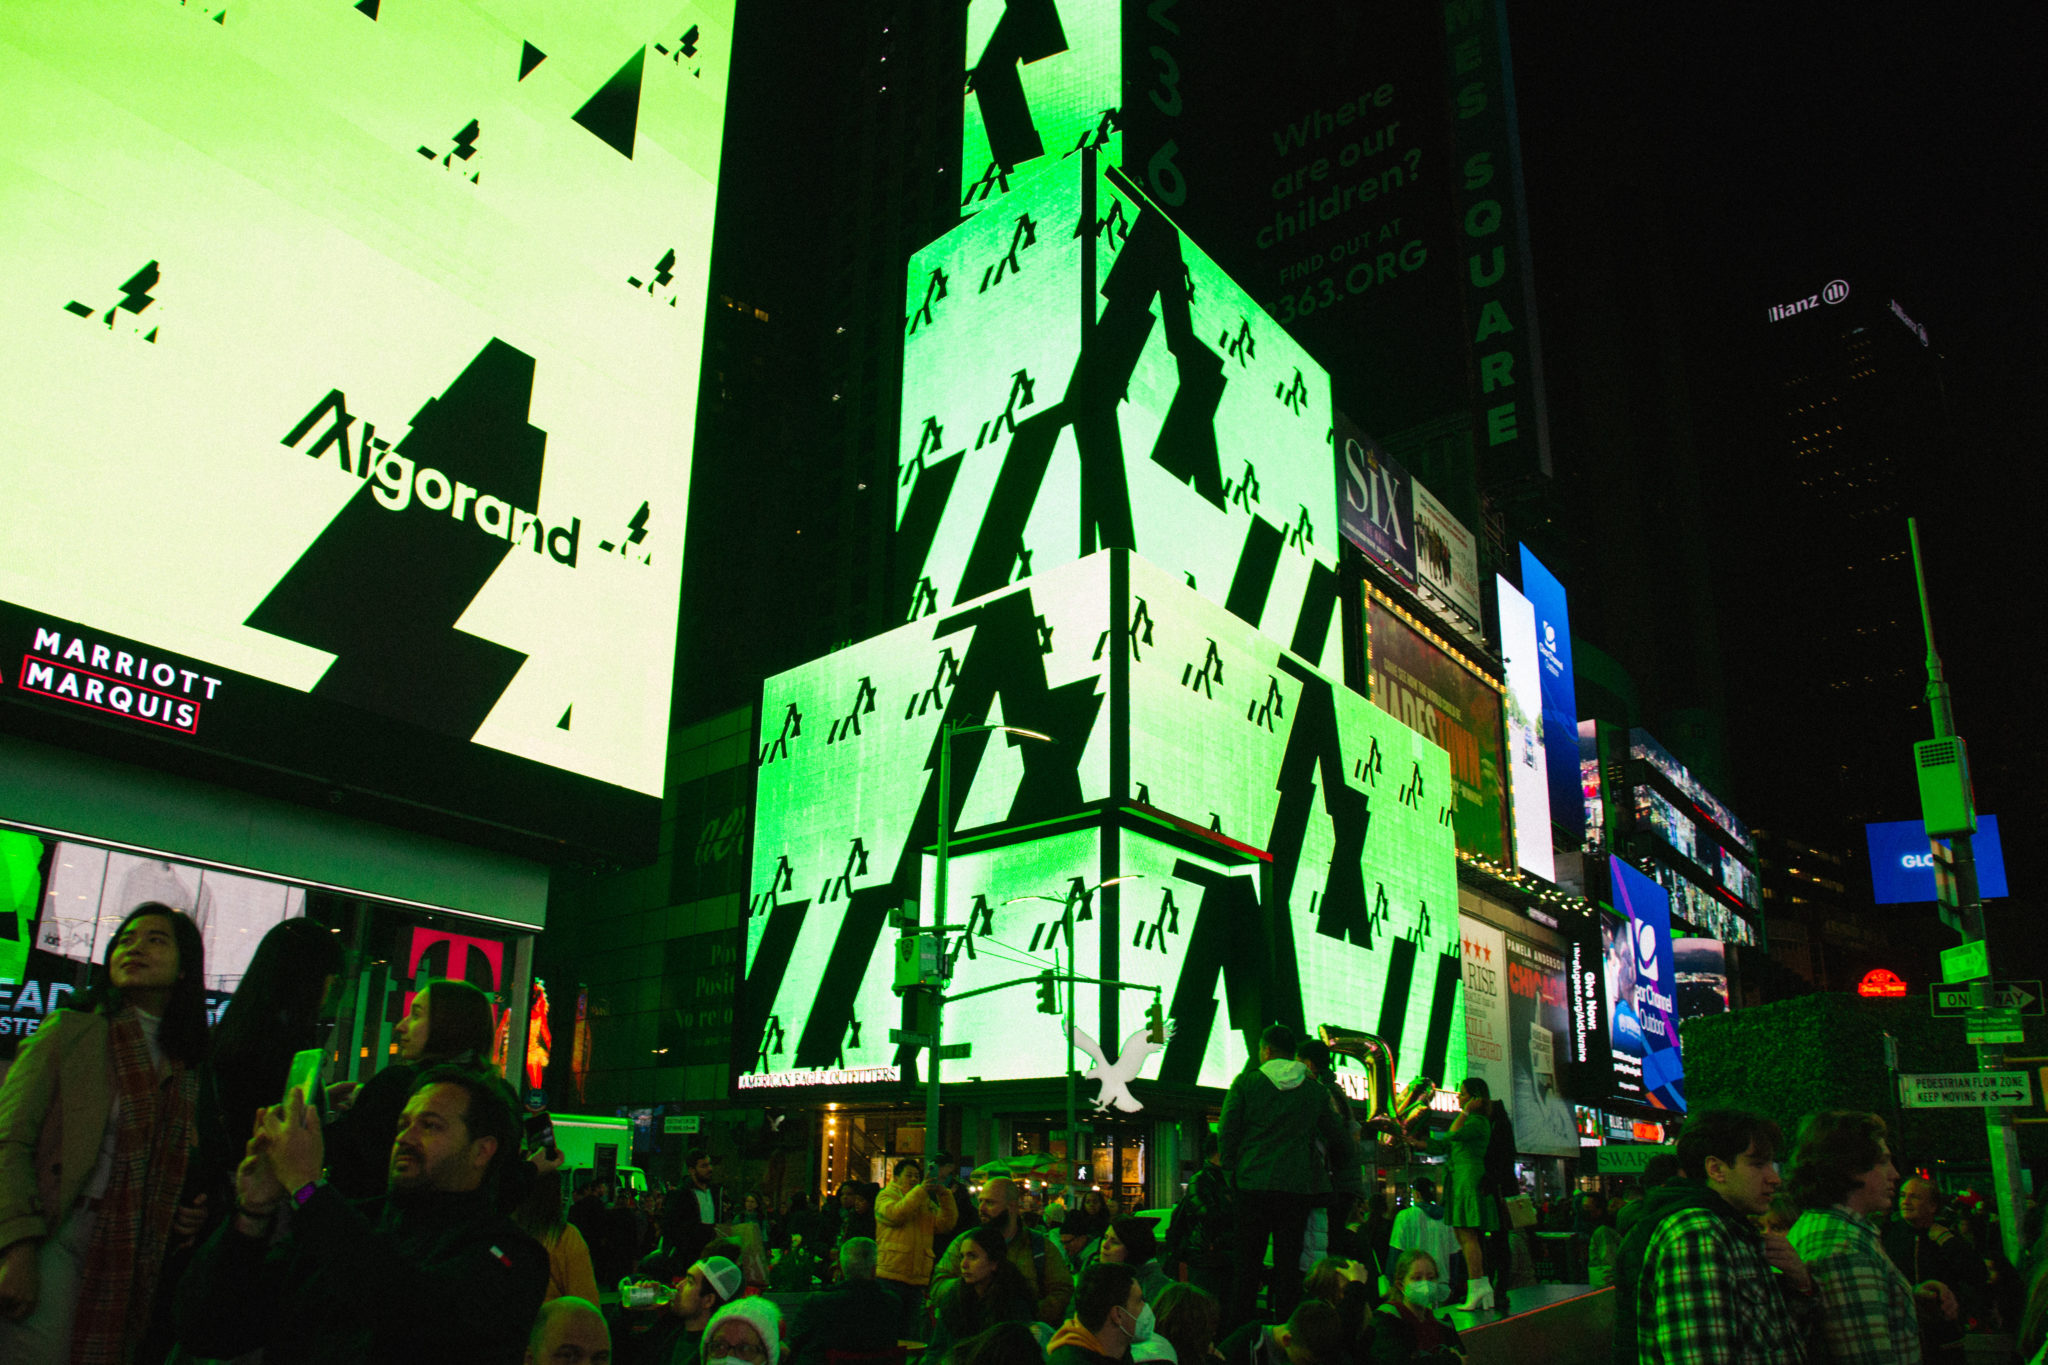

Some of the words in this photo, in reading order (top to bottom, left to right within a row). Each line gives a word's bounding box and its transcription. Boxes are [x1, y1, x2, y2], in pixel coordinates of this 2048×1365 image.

[1272, 83, 1395, 158] Where
[1271, 157, 1330, 200] are
[1338, 121, 1400, 168] our
[1255, 147, 1423, 249] children?
[1279, 253, 1325, 287] FIND
[1329, 231, 1371, 263] OUT
[1378, 217, 1401, 243] AT
[1463, 150, 1519, 447] SQUARE
[280, 388, 581, 569] Algorand
[1345, 438, 1408, 550] SIX
[26, 662, 194, 727] MARQUIS
[33, 627, 222, 700] MARRIOTT
[1467, 962, 1498, 997] RISE
[1506, 938, 1533, 959] PAMELA
[1584, 971, 1596, 999] Give
[1946, 993, 1972, 1006] ON
[1639, 1008, 1666, 1037] Outdoor
[1915, 1077, 1970, 1089] PEDESTRIAN
[1972, 1076, 1996, 1088] FLOW
[2000, 1075, 2024, 1087] ZONE
[1917, 1091, 1940, 1103] KEEP
[1942, 1090, 1977, 1102] MOVING
